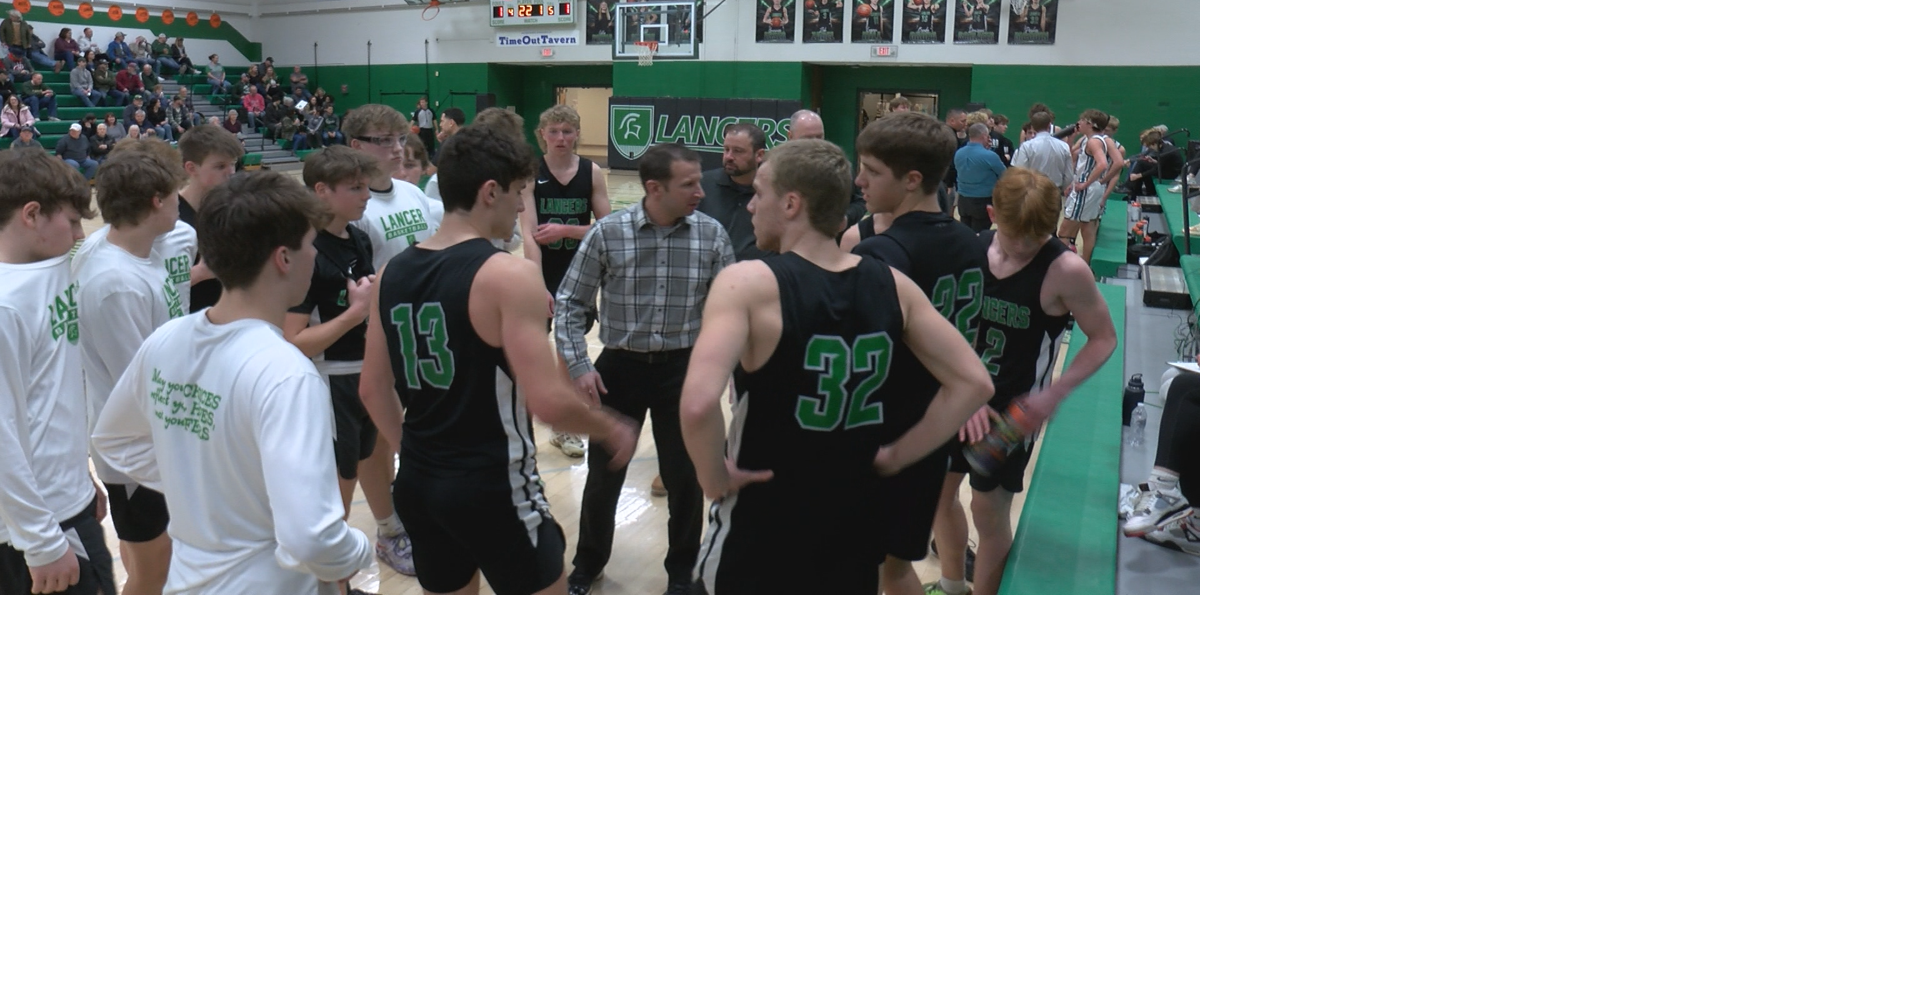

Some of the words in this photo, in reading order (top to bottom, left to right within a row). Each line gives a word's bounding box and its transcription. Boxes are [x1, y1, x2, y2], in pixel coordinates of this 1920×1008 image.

[518, 5, 533, 17] 22
[540, 198, 588, 215] LANCERS
[380, 208, 426, 232] LANCER
[390, 302, 456, 390] 13
[795, 331, 894, 432] 32
